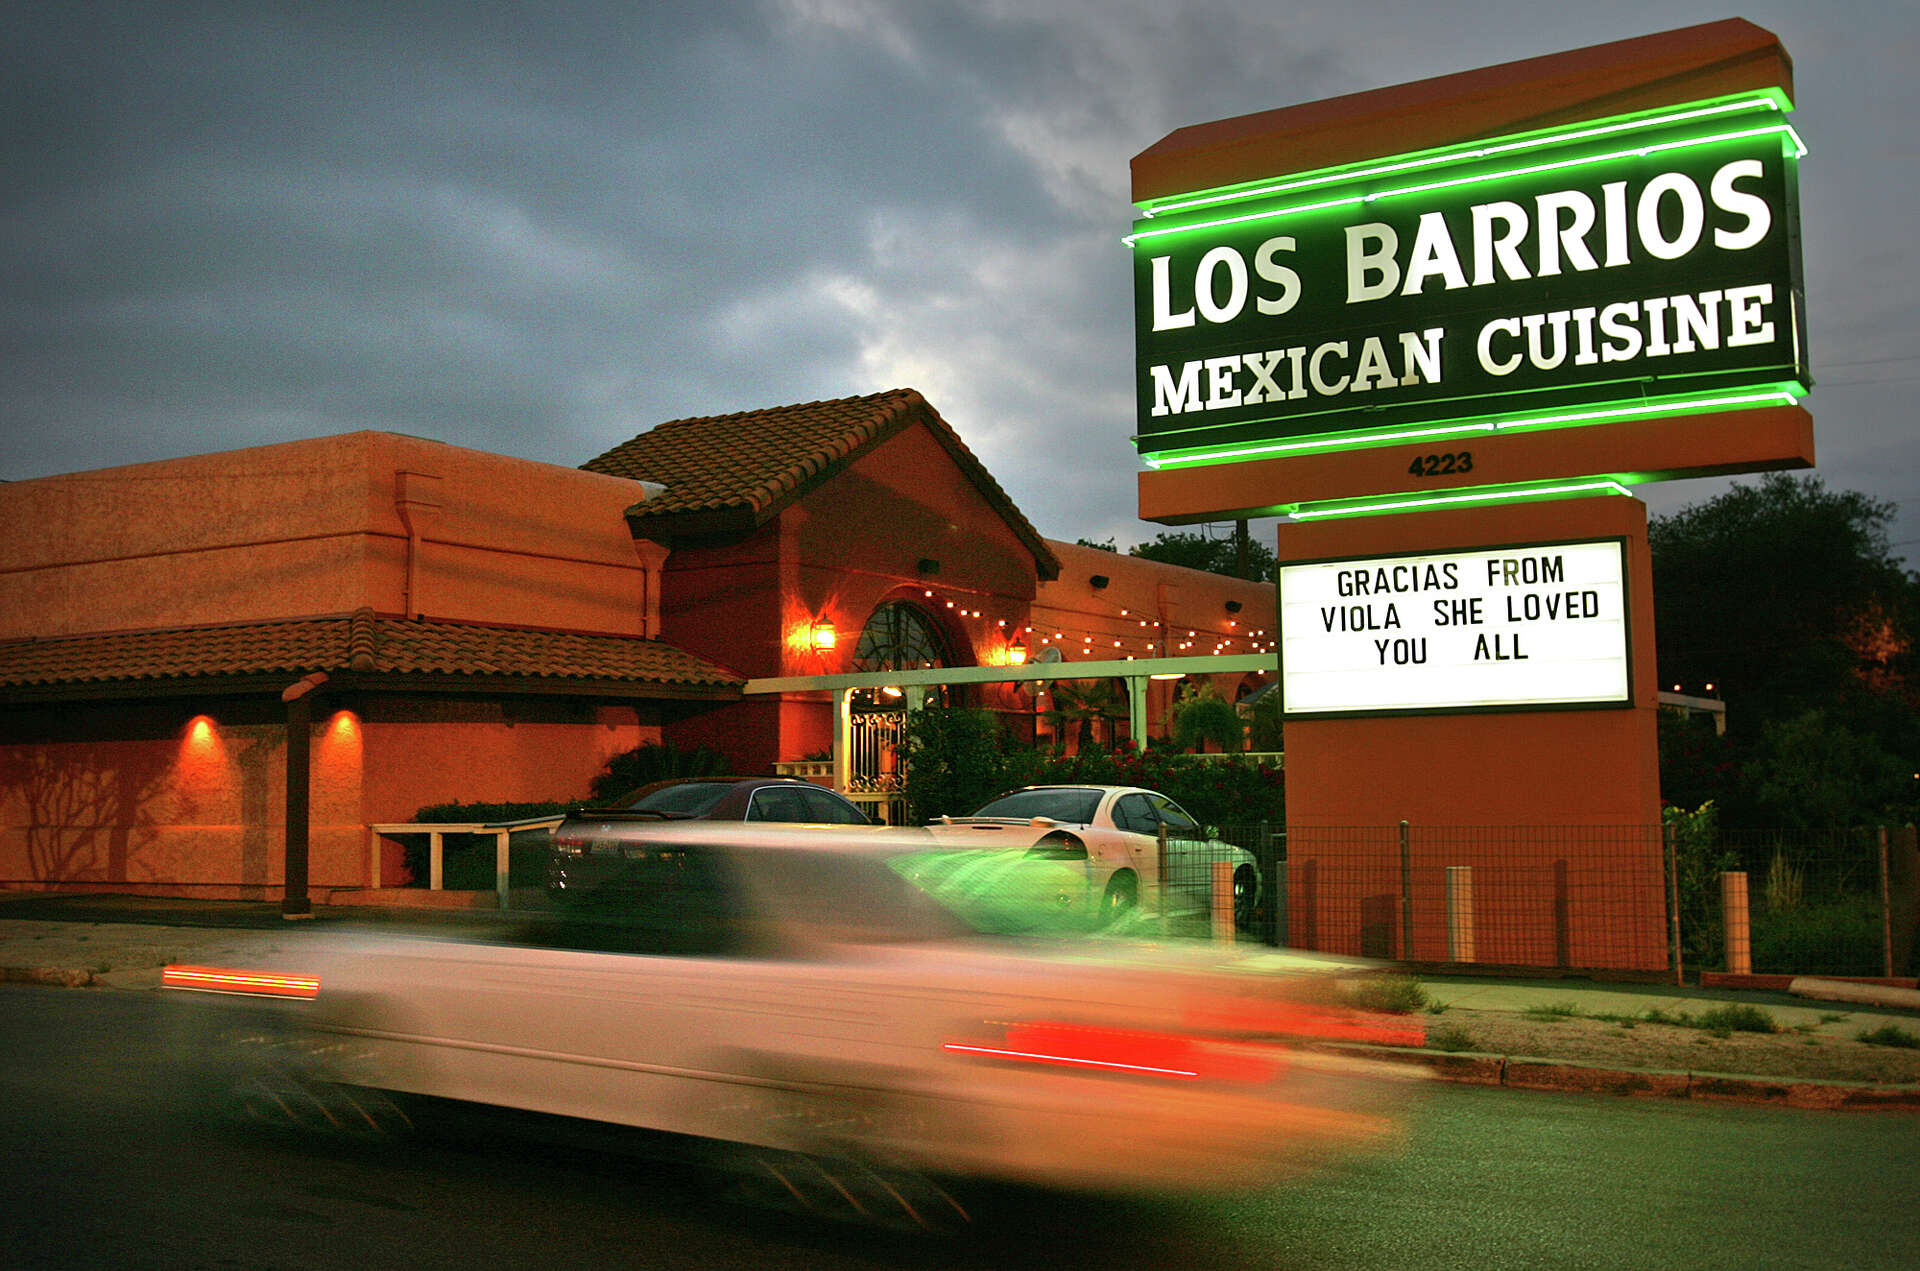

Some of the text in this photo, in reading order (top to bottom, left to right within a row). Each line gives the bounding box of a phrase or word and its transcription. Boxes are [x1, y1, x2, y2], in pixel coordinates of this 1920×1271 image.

[1151, 159, 1772, 332] LOS BARRIOS
[1151, 283, 1775, 417] MEXICAN CUISINE
[1408, 452, 1473, 477] 4223
[1337, 555, 1564, 597] GRACIAS FROM
[1321, 590, 1599, 632] VIOLA SHE LOVED
[1375, 633, 1529, 665] YOU ALL
